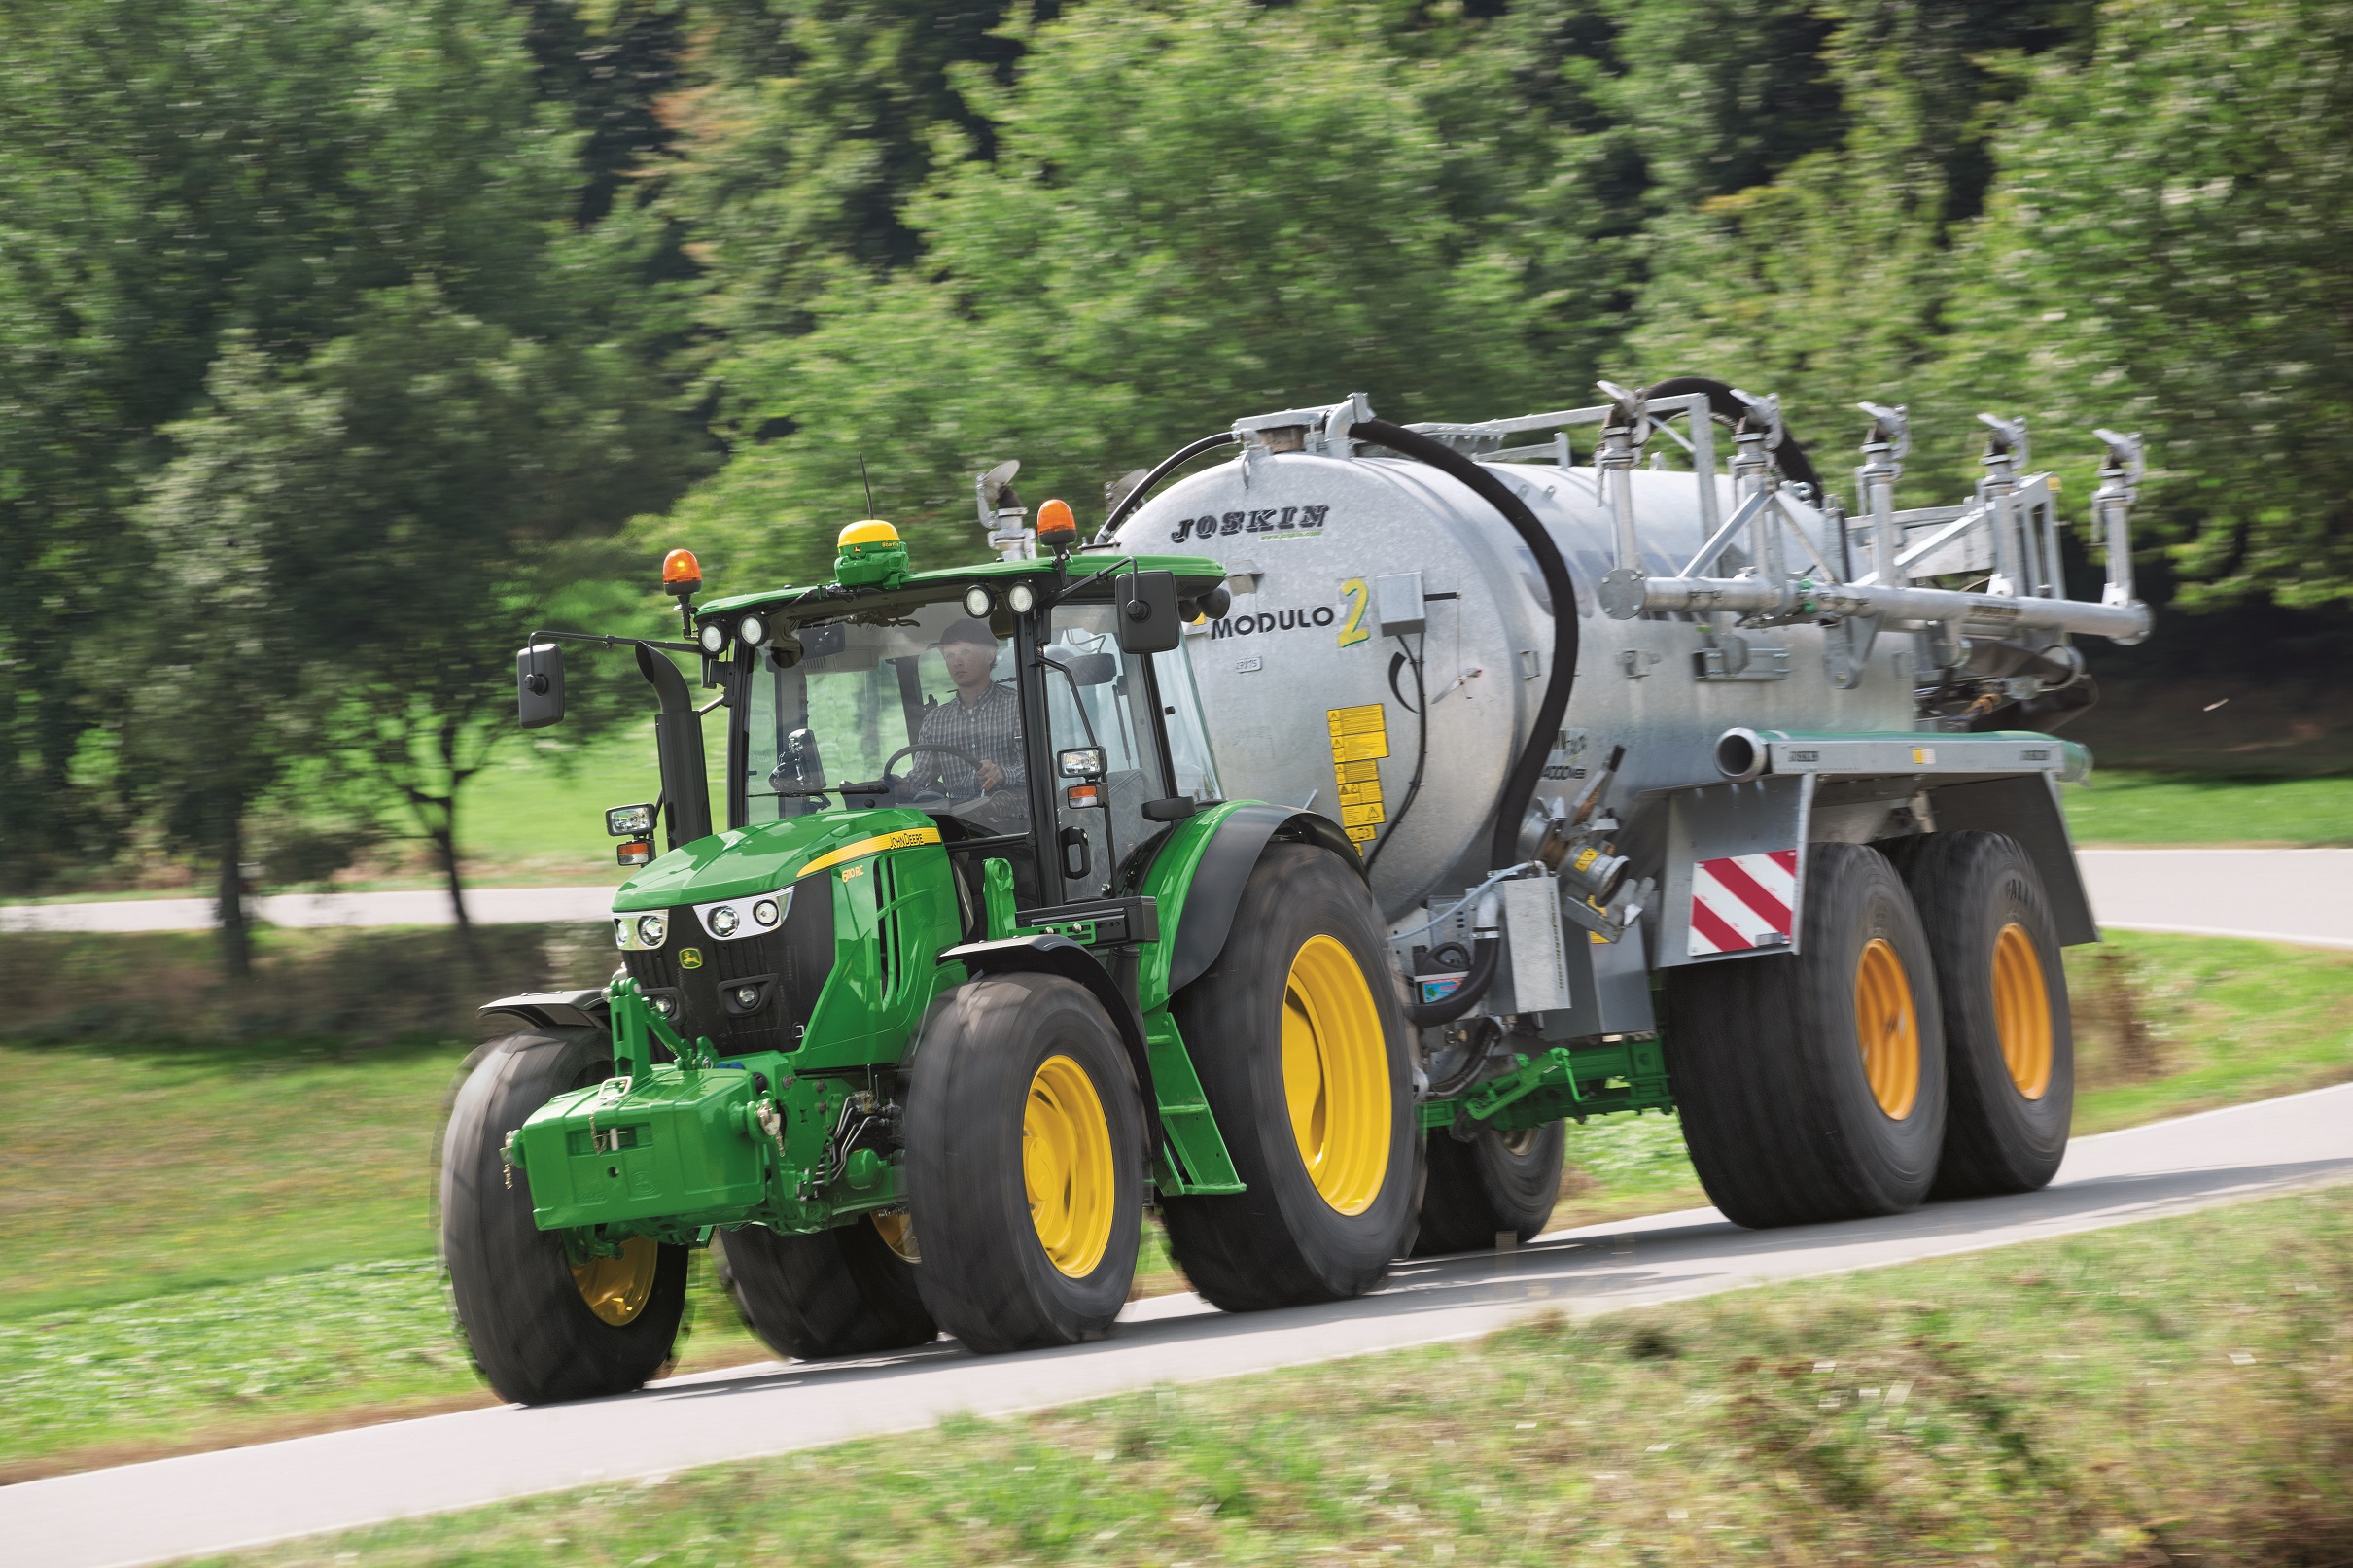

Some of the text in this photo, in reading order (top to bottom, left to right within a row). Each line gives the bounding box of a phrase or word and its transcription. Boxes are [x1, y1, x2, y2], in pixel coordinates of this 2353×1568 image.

[1171, 505, 1329, 543] JOSKIN
[1212, 578, 1369, 648] MODULO 2
[890, 833, 925, 850] JOHN DEERE
